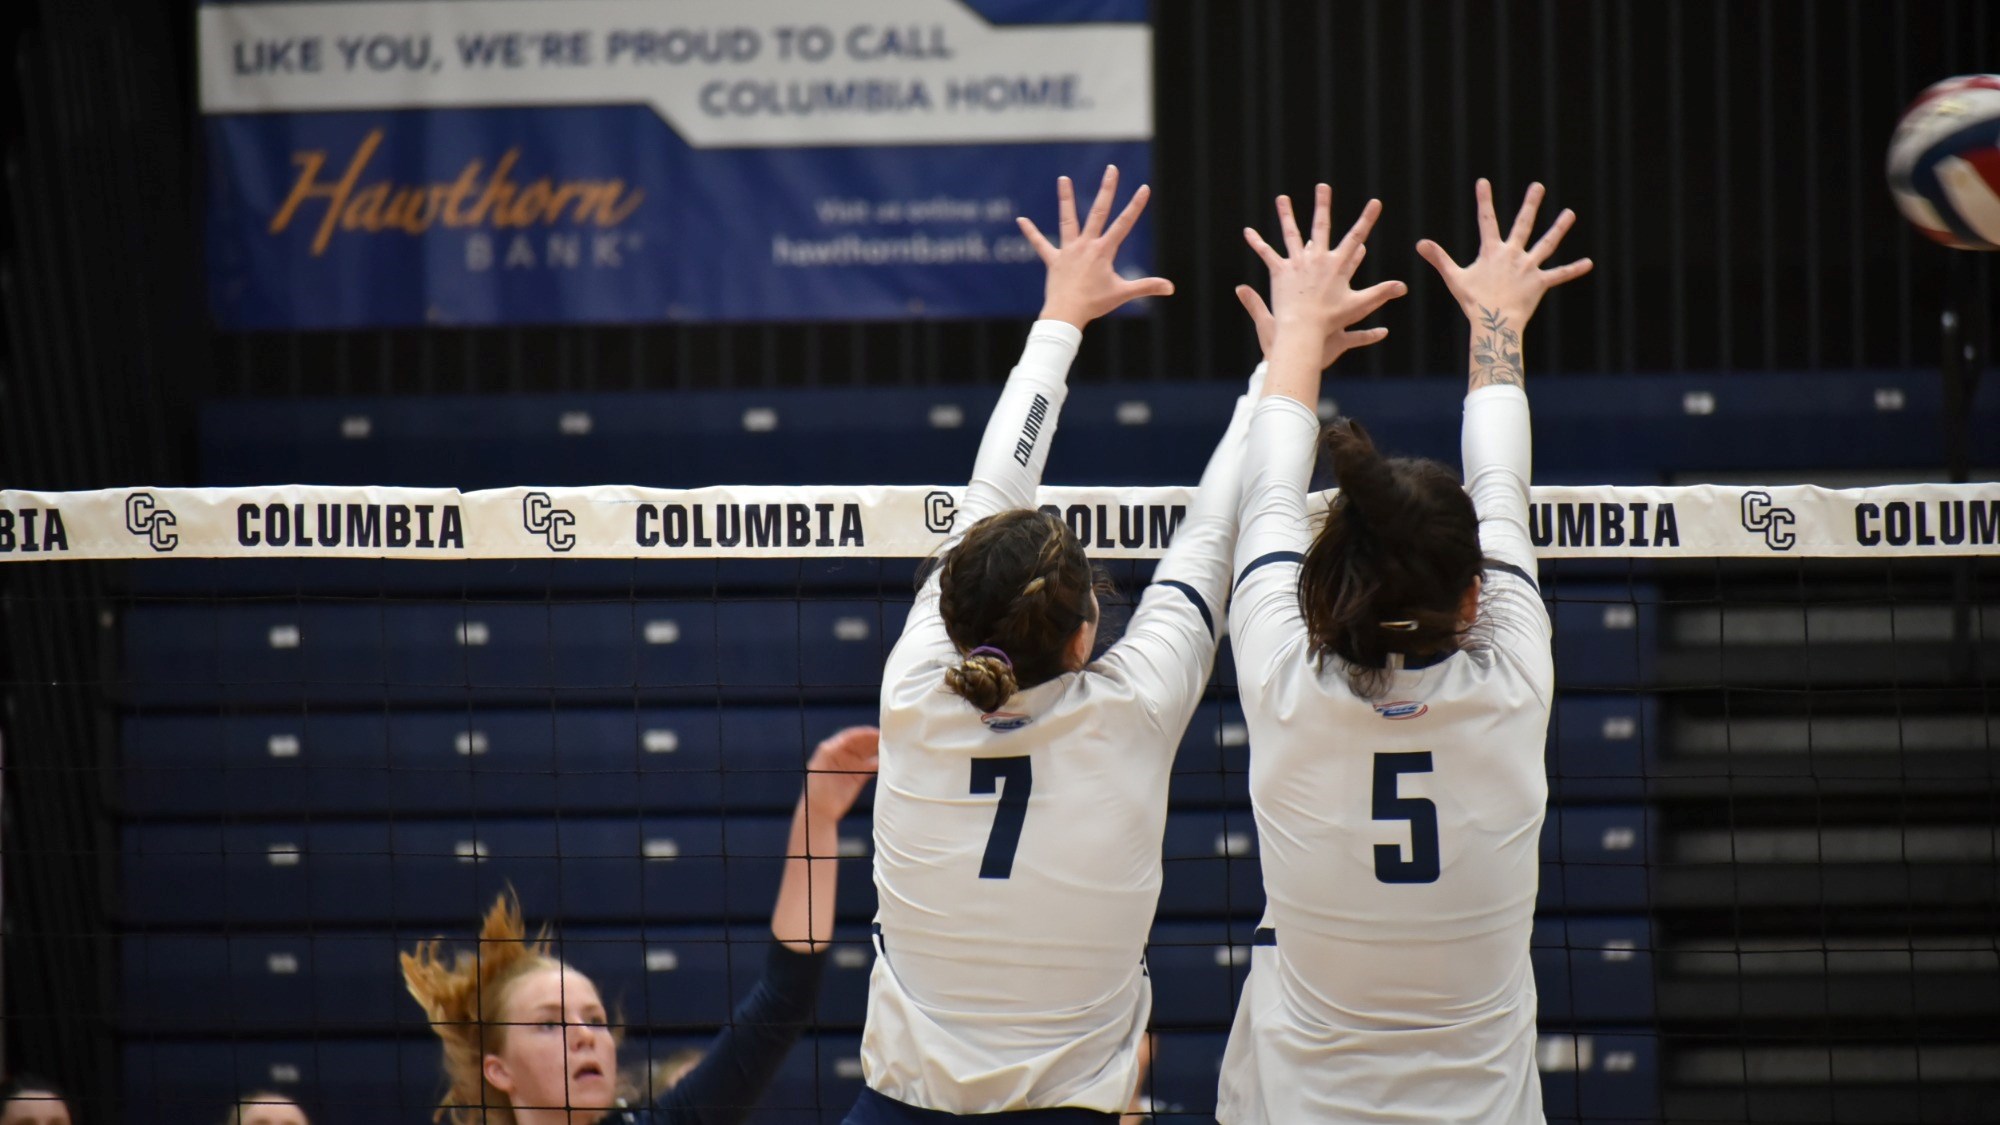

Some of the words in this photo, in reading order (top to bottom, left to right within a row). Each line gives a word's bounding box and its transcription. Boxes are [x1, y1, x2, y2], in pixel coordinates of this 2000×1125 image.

[232, 36, 322, 76] LIKE
[336, 34, 441, 74] YOU,
[456, 31, 594, 69] WE'RE
[606, 29, 761, 66] PROUD
[773, 27, 833, 62] TO
[846, 25, 954, 61] CALL
[699, 78, 929, 117] COLUMBIA
[947, 74, 1095, 112] HOME.
[269, 128, 645, 257] Hawthorn
[1013, 393, 1049, 468] COLUMBIA
[0, 508, 69, 552] BIA
[237, 503, 464, 549] COLUMBIA
[636, 503, 865, 548] COLUMBIA
[925, 491, 958, 534] C
[1037, 504, 1186, 549] OLUM
[1529, 503, 1680, 547] UMBIA
[1854, 500, 2000, 547] COLUM
[969, 755, 1032, 879] 7
[1372, 751, 1441, 884] 5
